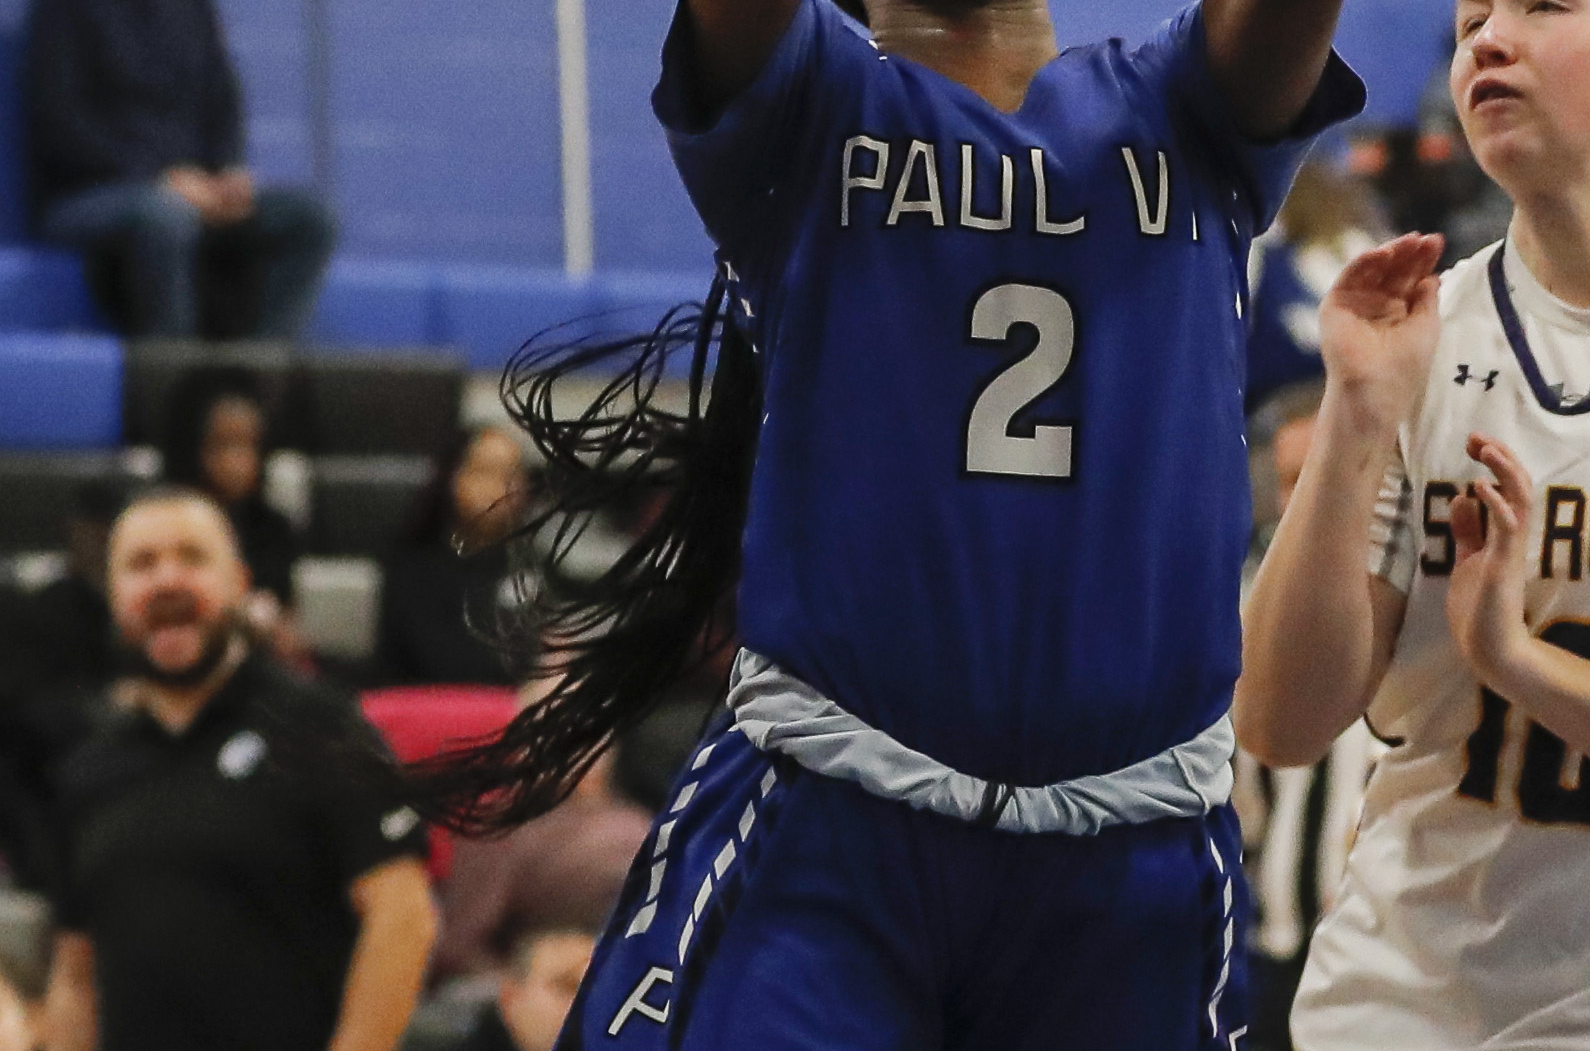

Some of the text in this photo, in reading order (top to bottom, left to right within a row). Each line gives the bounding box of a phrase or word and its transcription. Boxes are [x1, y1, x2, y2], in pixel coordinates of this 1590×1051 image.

[841, 135, 1198, 240] PAUL V
[966, 283, 1074, 477] 2
